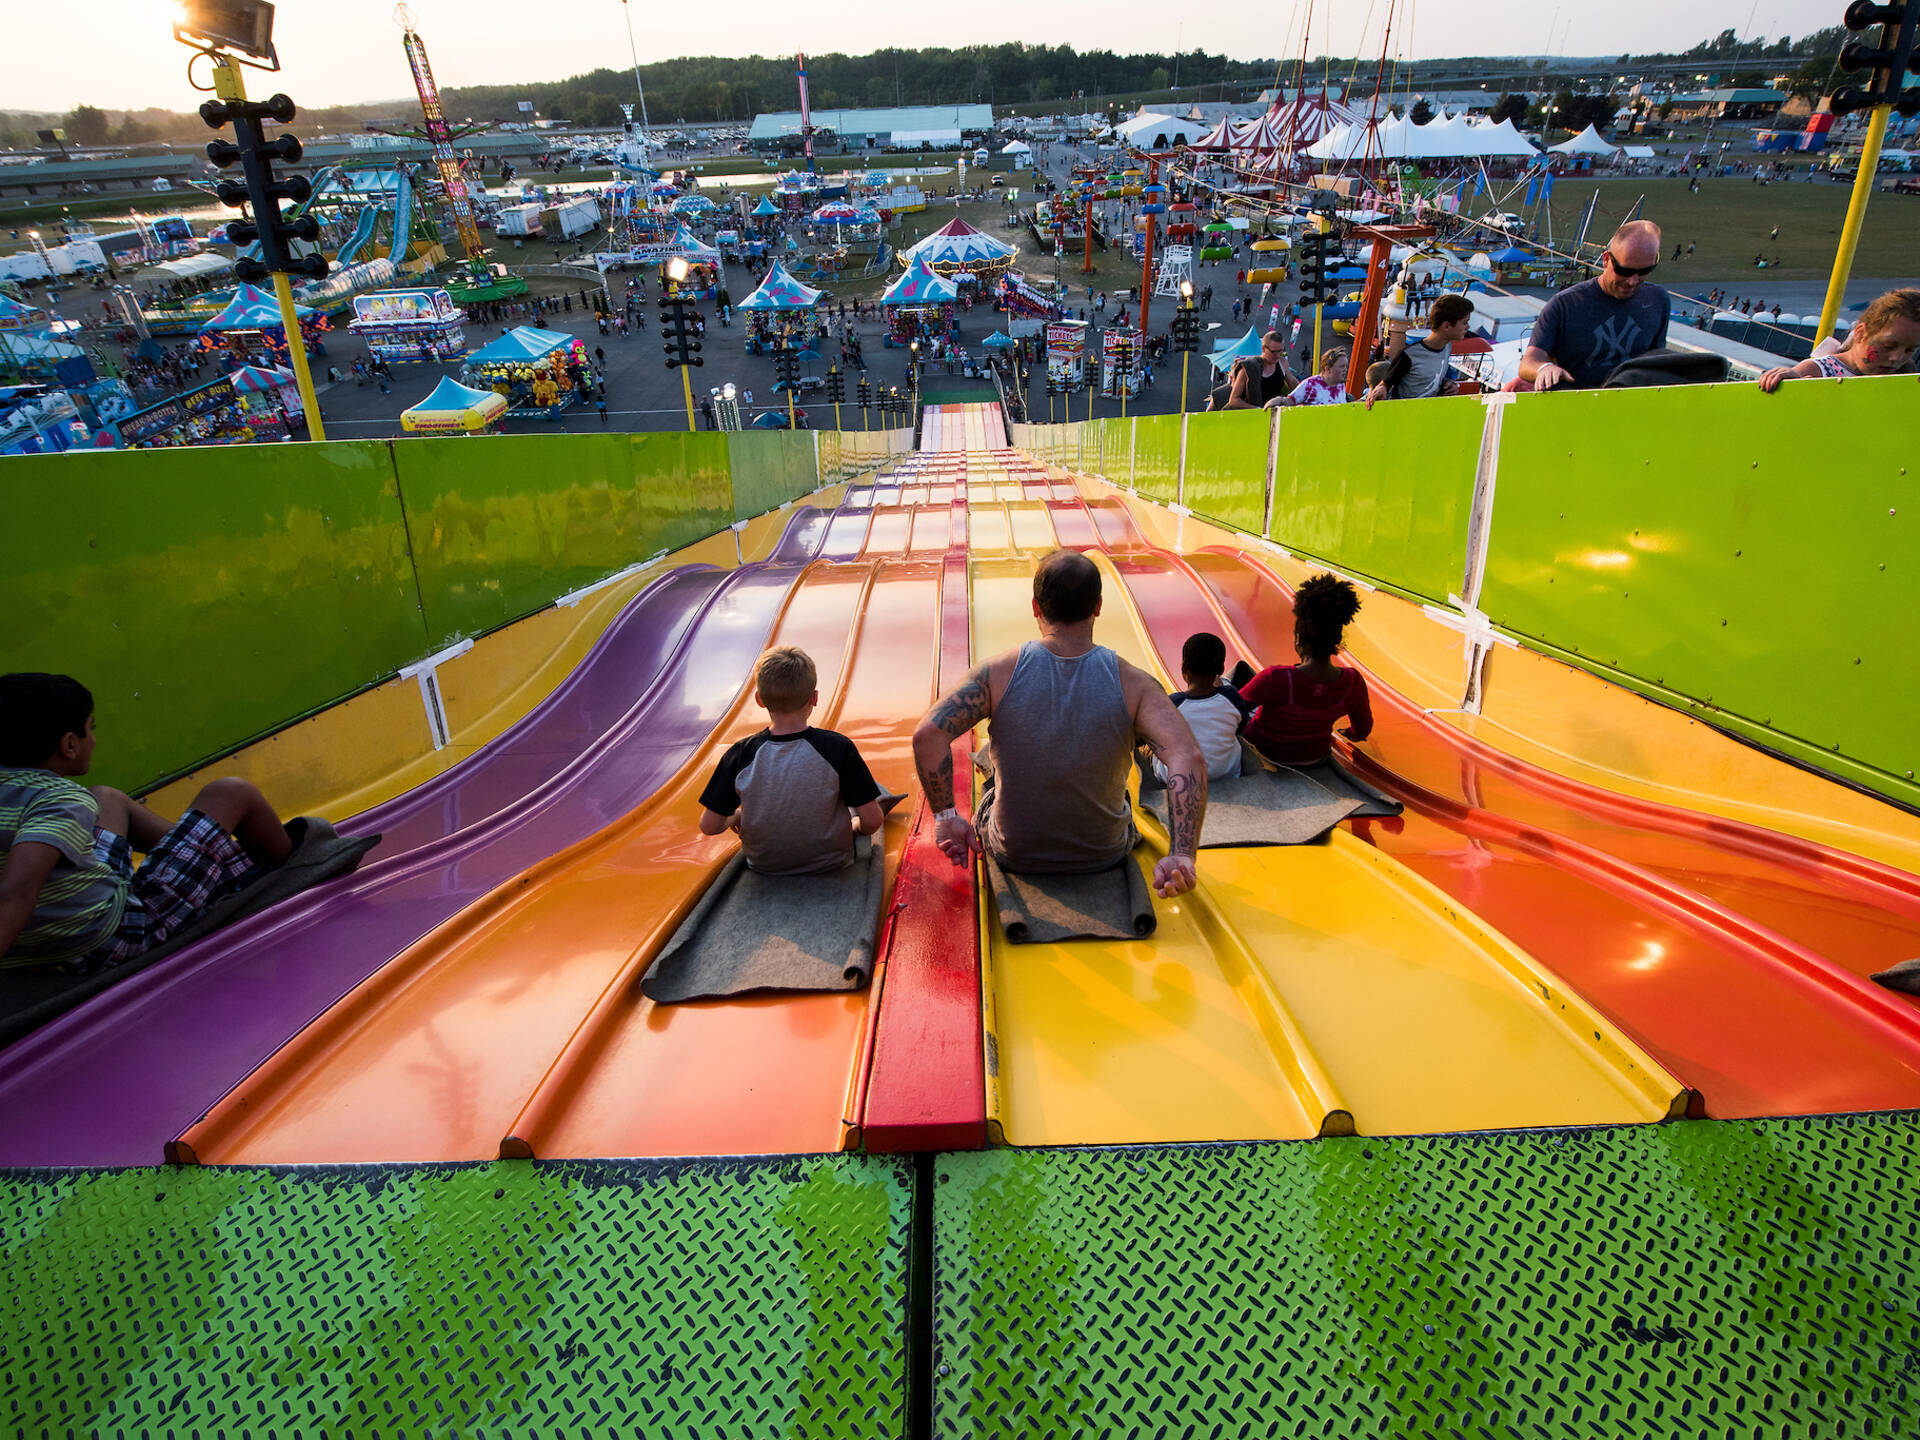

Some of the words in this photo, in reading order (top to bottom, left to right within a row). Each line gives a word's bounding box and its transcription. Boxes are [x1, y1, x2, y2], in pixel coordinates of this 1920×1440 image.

[634, 246, 682, 255] AMAZING
[1378, 258, 1386, 269] 4
[1049, 331, 1073, 341] TICKETS
[1585, 315, 1641, 367] NY
[209, 384, 230, 394] BUST
